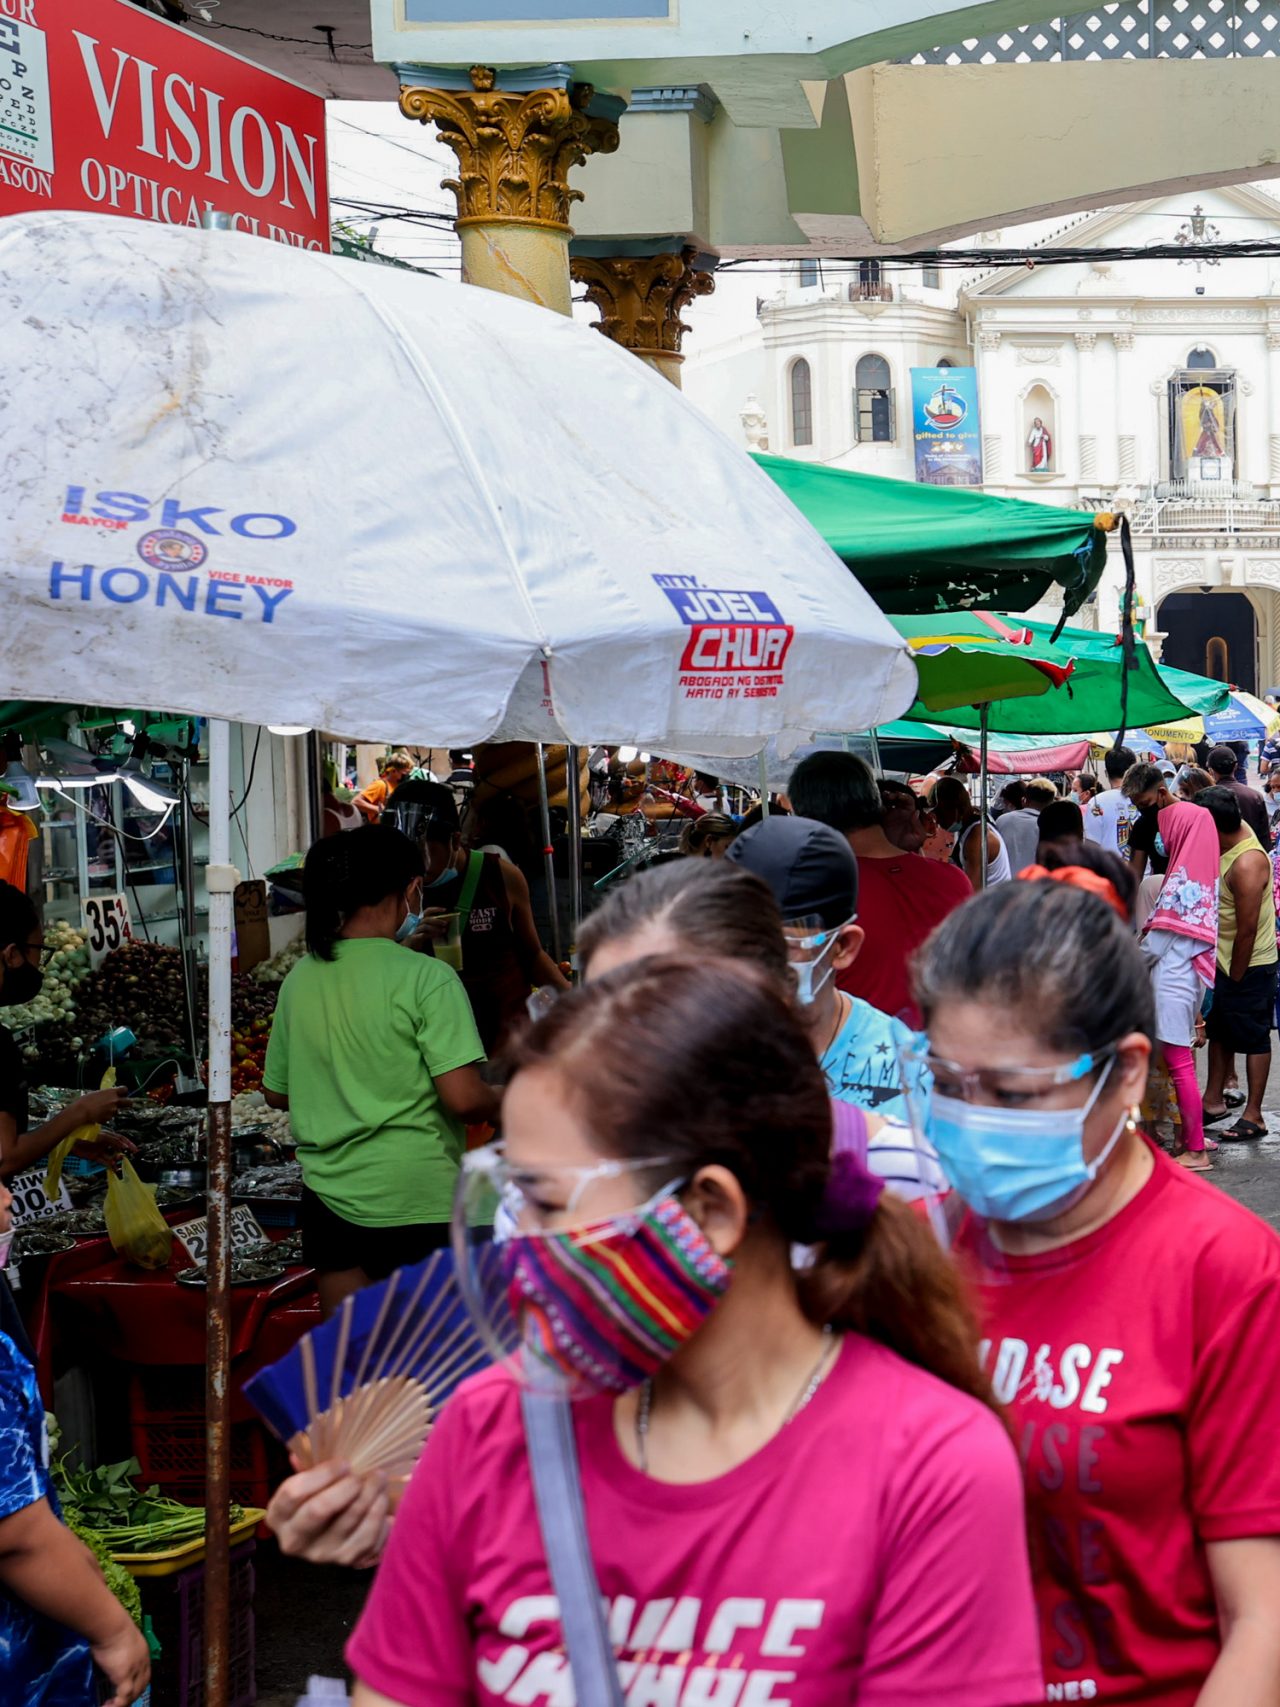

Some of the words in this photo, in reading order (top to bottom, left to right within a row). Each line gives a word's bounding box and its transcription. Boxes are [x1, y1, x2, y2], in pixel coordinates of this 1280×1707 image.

[71, 29, 318, 219] VISION
[60, 512, 129, 531] MAYOR
[63, 484, 297, 540] ISKO
[50, 560, 294, 624] HONEY
[208, 569, 241, 583] VICE
[244, 574, 294, 589] MAYOR
[682, 591, 775, 622] JOEL
[690, 626, 789, 669] CHUA
[679, 676, 734, 687] ABOGADO
[737, 675, 751, 686] NG
[86, 900, 120, 952] 35
[470, 906, 497, 919] EAST
[11, 1202, 65, 1226] UMPOK
[1046, 1678, 1098, 1702] NES
